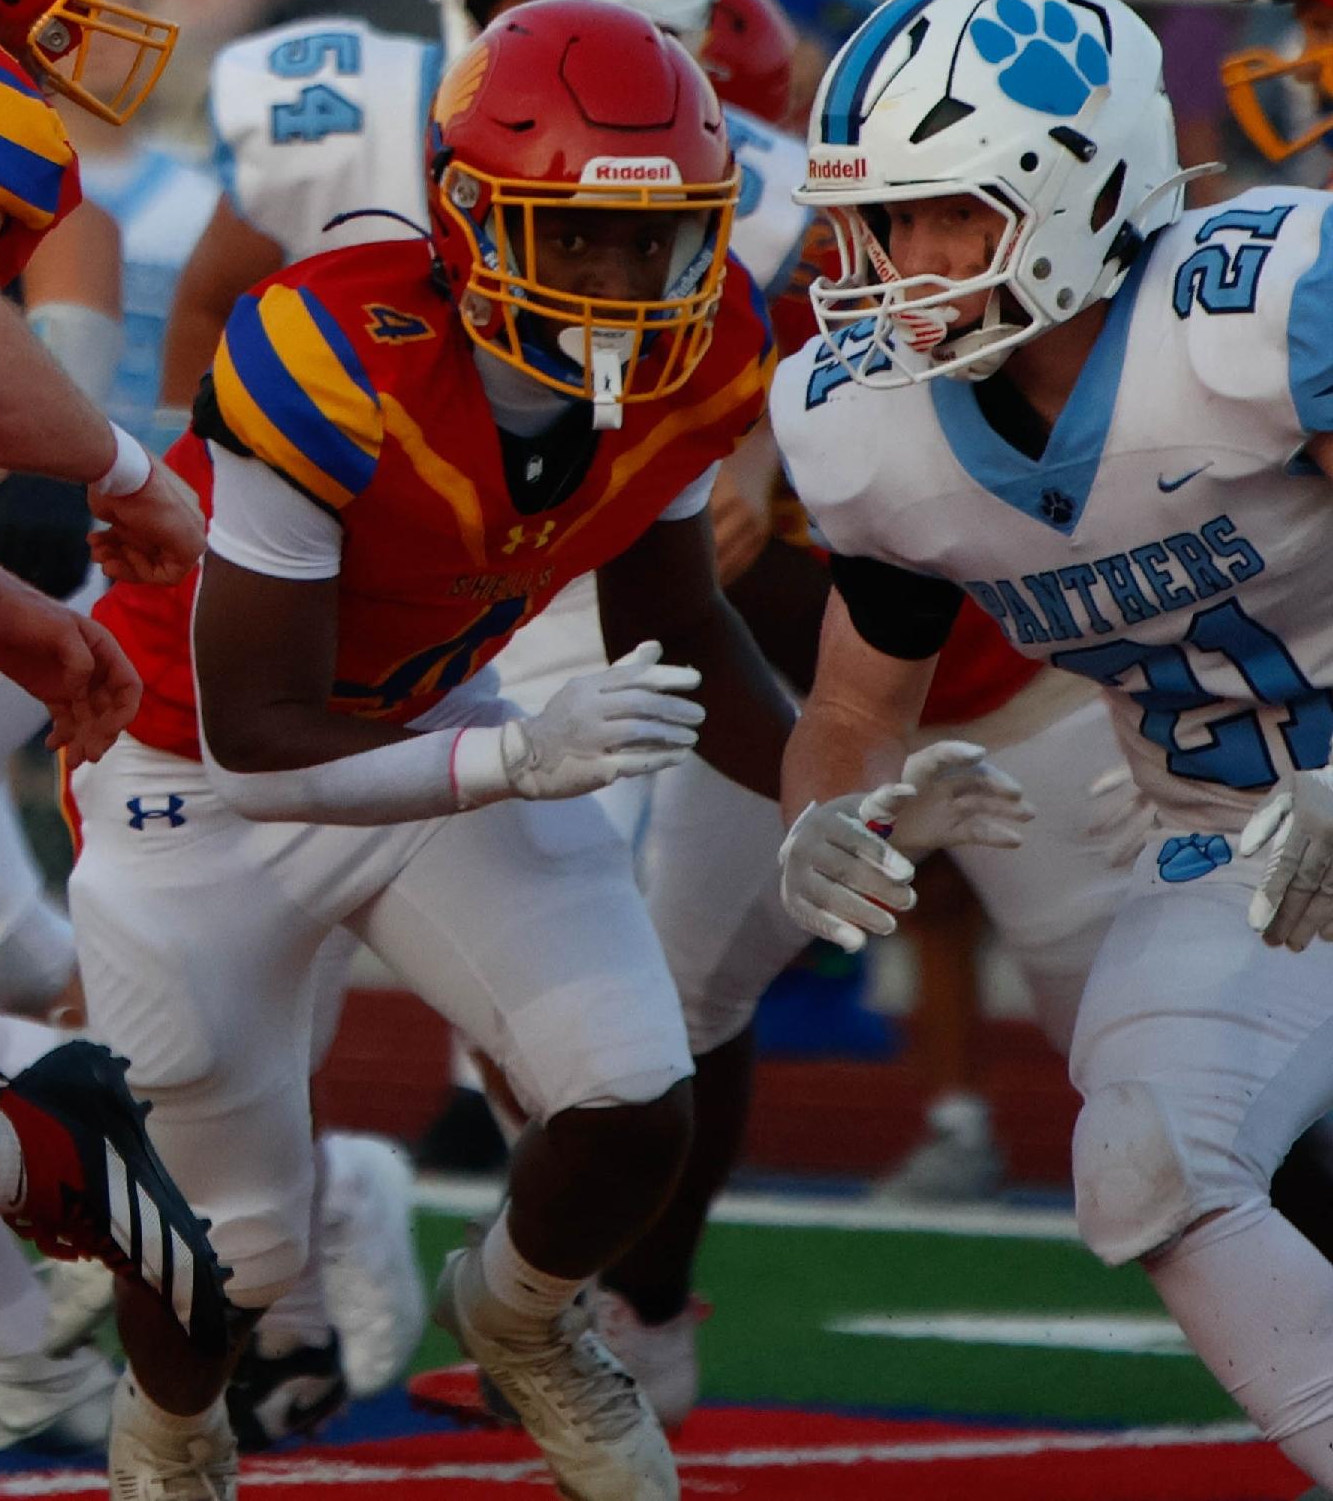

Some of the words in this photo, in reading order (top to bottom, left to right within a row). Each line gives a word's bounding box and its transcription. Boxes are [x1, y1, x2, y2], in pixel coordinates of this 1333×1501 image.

[595, 164, 672, 181] Riddell
[809, 157, 867, 179] Riddell
[1173, 203, 1298, 320] 21
[963, 514, 1266, 646] PANTHERS
[1050, 595, 1333, 790] 21
